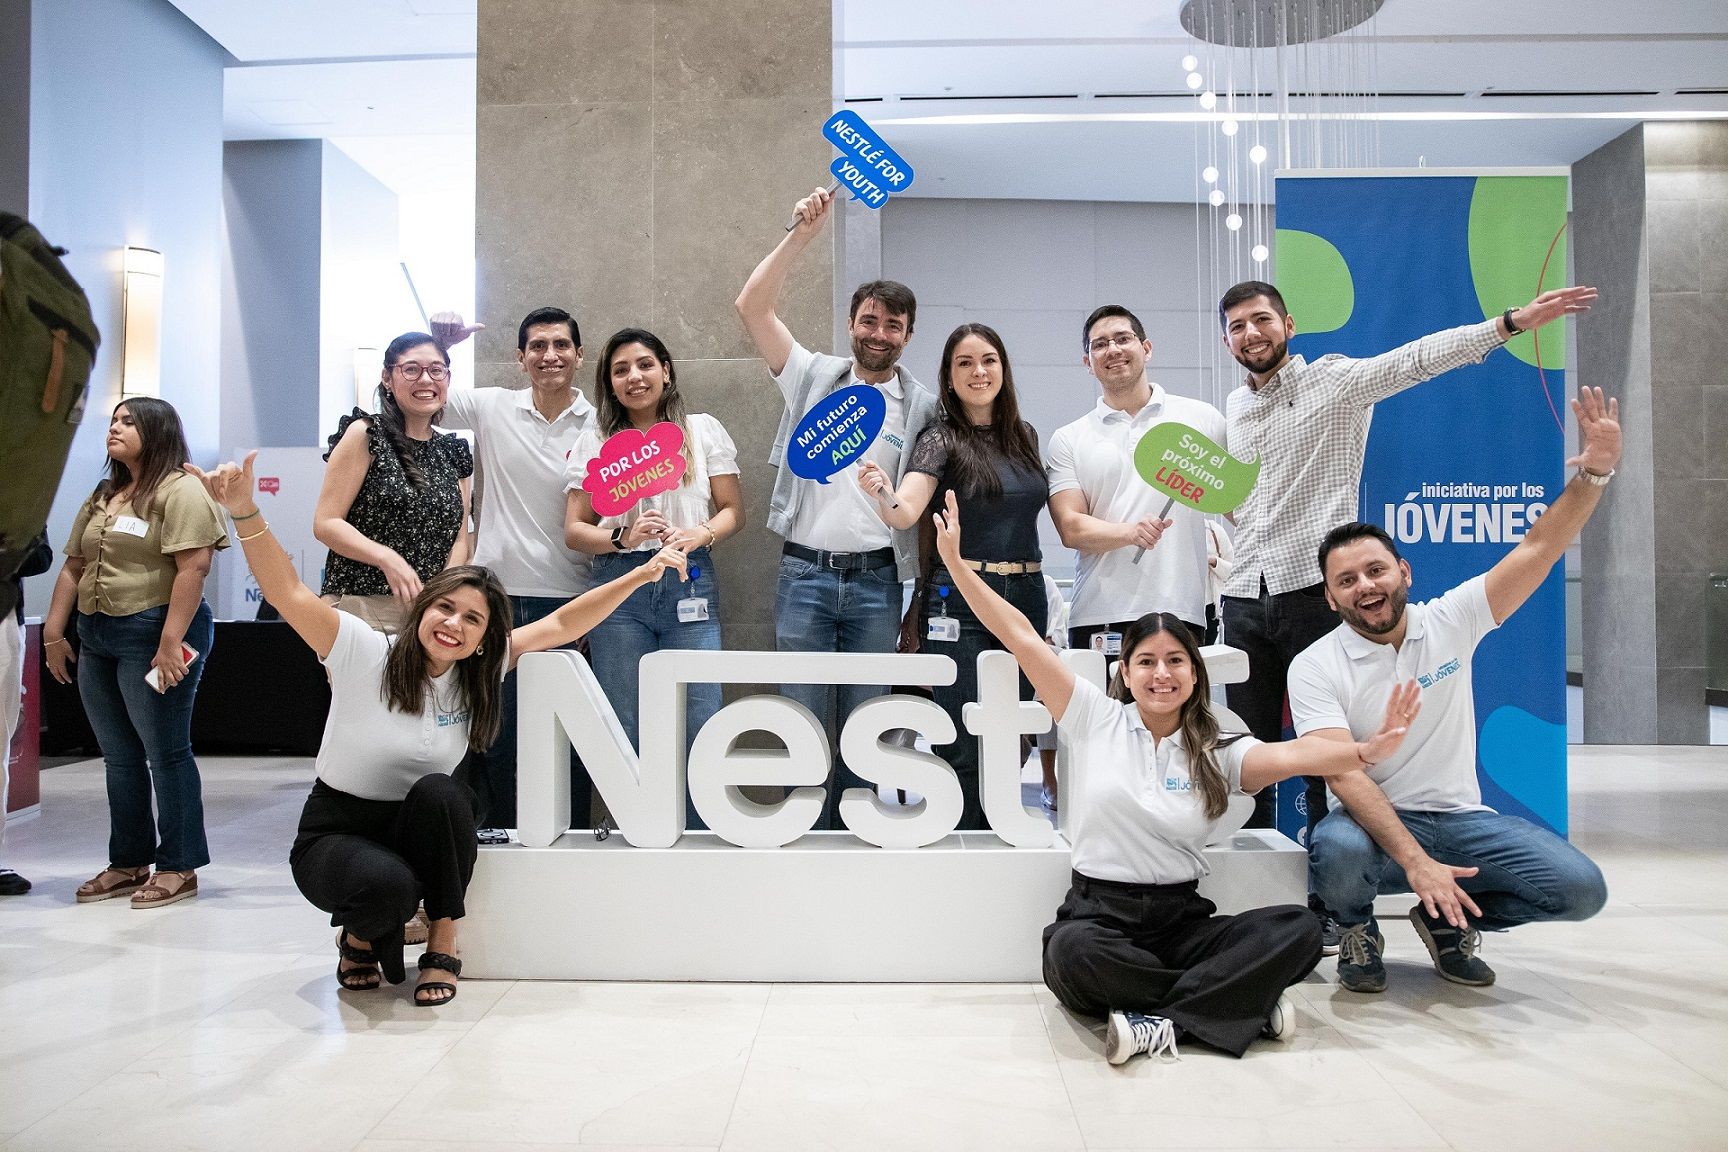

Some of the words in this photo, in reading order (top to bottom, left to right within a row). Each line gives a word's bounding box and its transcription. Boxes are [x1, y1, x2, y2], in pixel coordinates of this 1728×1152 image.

[831, 120, 884, 164] NESTLÉ
[875, 159, 905, 186] FOR
[838, 161, 885, 204] YOUTH
[797, 427, 817, 448] Mi
[816, 395, 857, 431] futuro
[806, 406, 867, 459] comienza
[599, 456, 632, 482] POR
[632, 440, 660, 465] LOS
[831, 425, 867, 465] AQUÍ
[1179, 434, 1208, 460] Soy
[1210, 455, 1227, 469] el
[608, 458, 675, 502] JÓVENES
[1155, 466, 1205, 504] LÍDER
[1160, 448, 1224, 490] próximo
[1422, 482, 1490, 498] iniciativa
[1493, 484, 1518, 501] por
[1521, 482, 1544, 498] los
